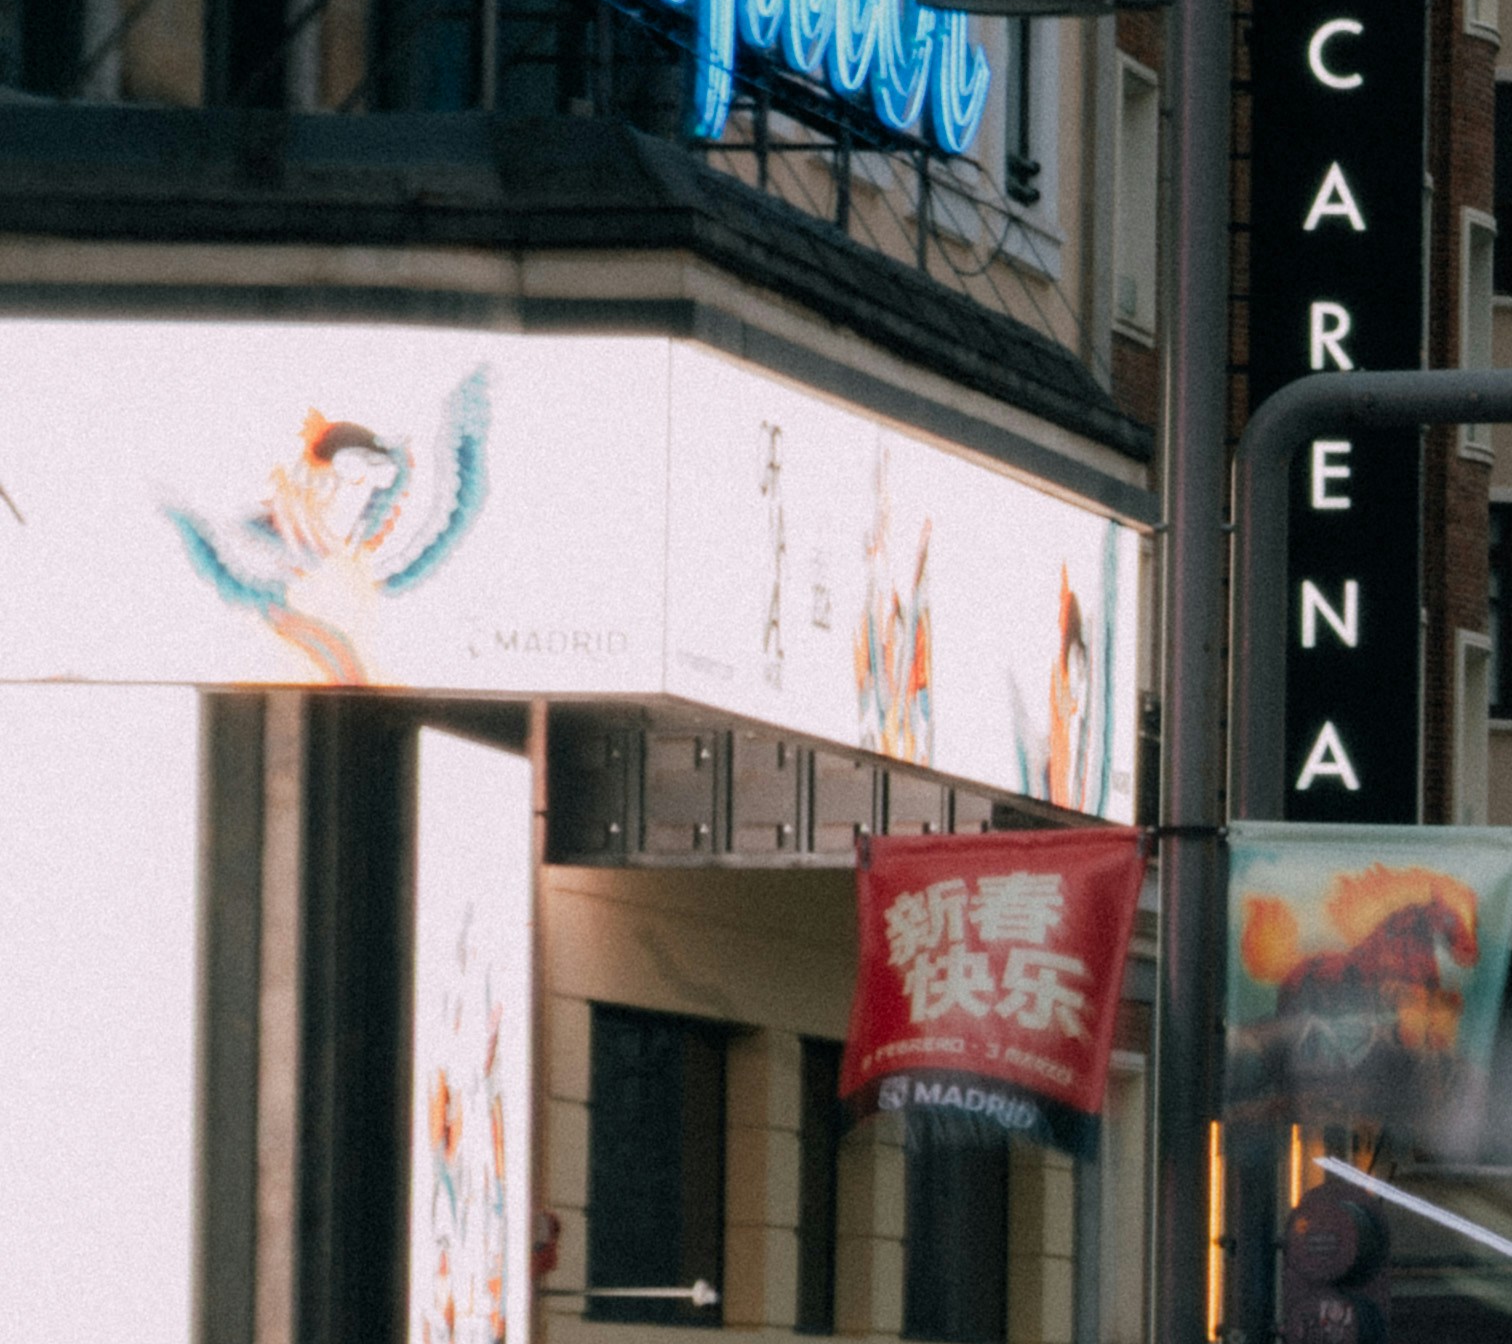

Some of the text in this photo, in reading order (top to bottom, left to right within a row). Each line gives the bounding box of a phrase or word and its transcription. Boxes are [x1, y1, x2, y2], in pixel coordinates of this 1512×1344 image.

[494, 627, 629, 657] MADRID
[884, 869, 1066, 968] 新春
[901, 942, 1092, 1040] 快乐
[913, 1080, 1038, 1130] MADRID
